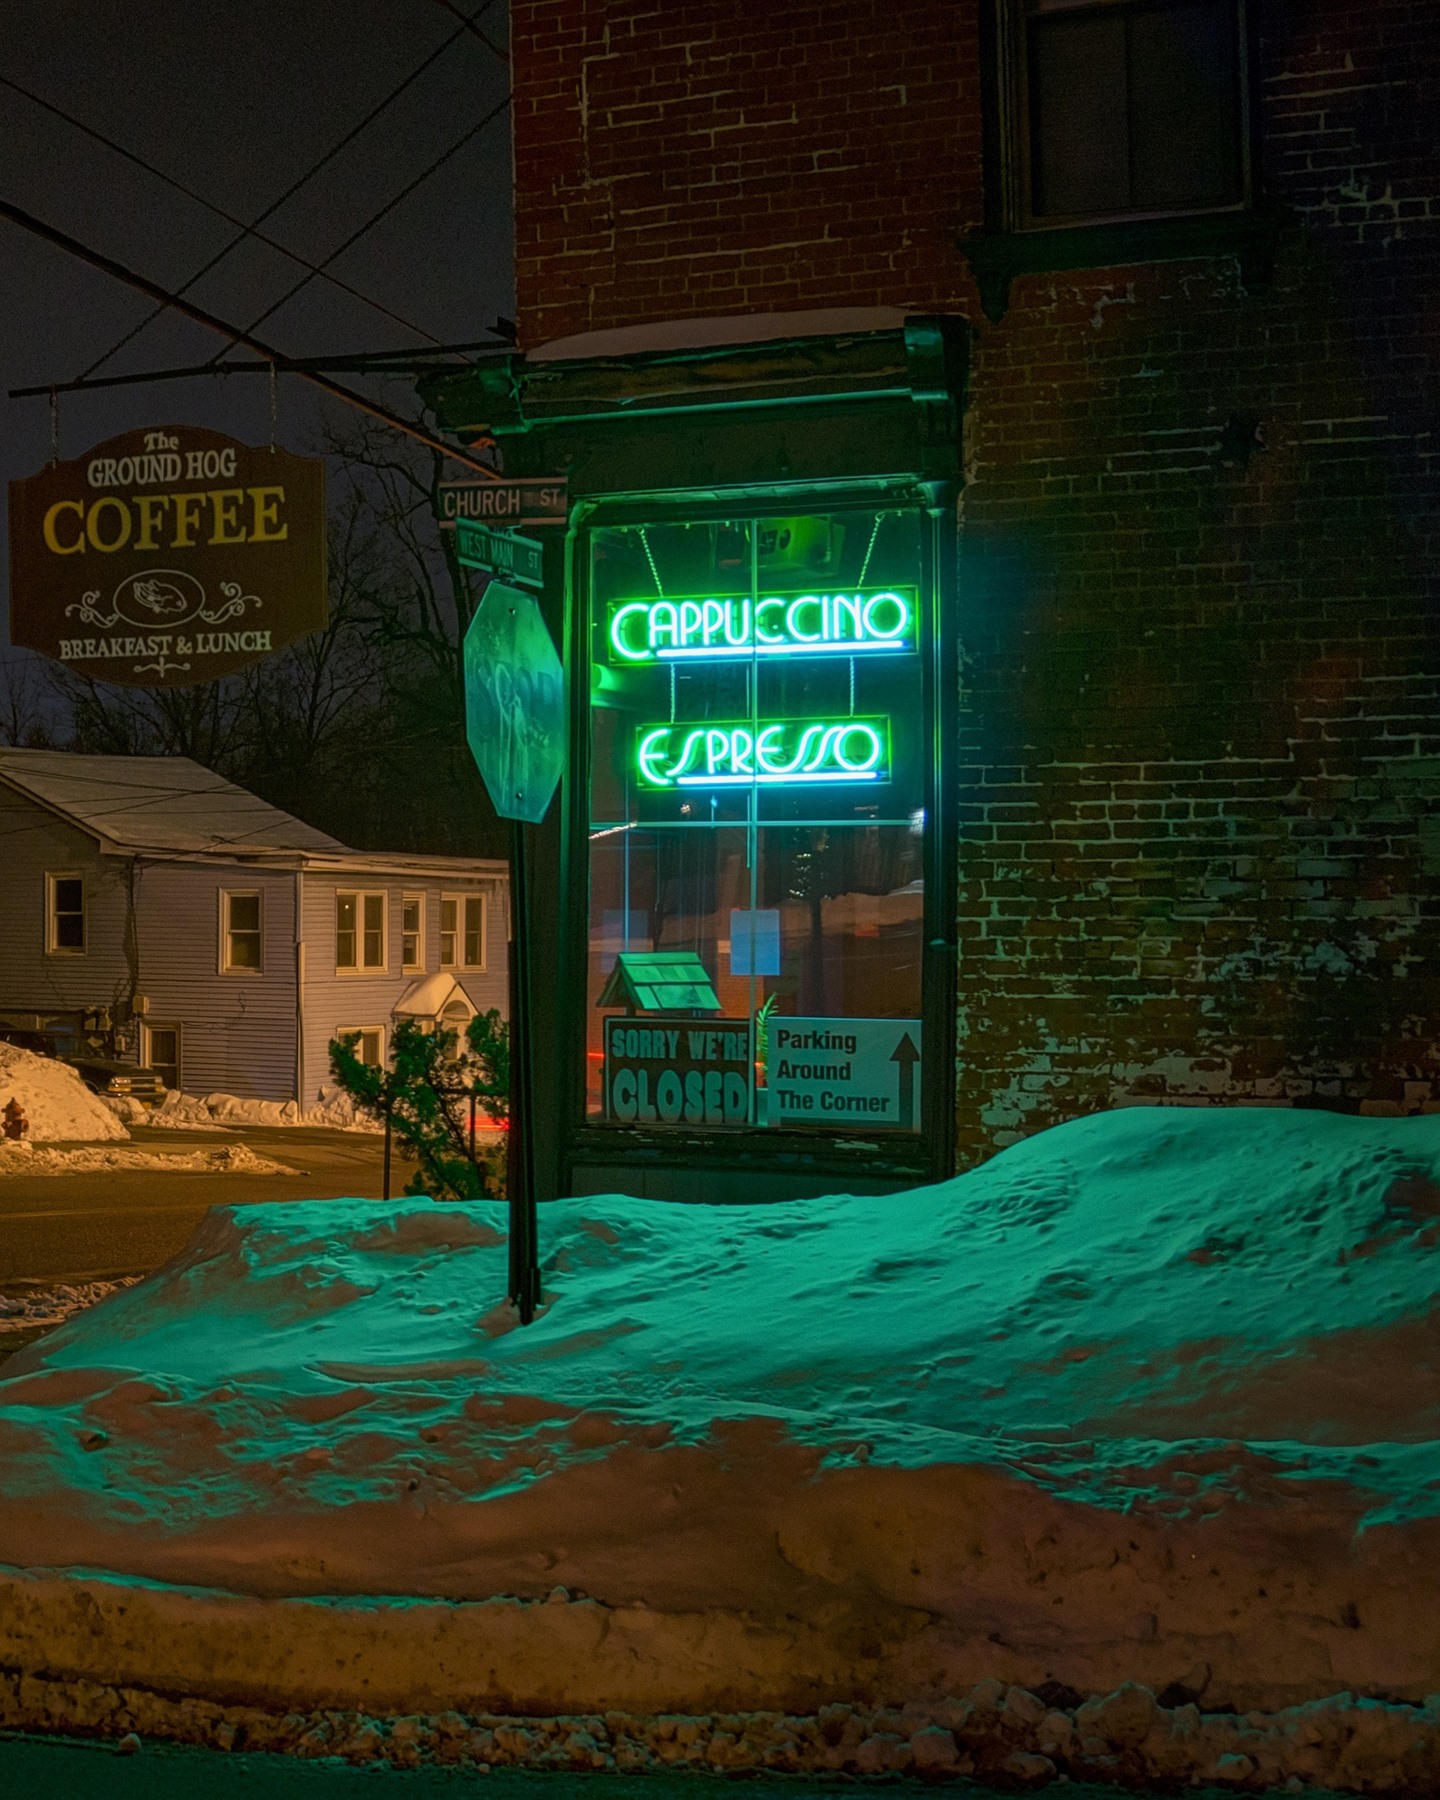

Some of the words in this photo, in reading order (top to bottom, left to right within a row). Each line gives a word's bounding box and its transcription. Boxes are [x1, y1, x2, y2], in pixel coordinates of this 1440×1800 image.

[144, 432, 179, 451] The
[87, 454, 182, 487] GROUND
[185, 447, 237, 480] HOG
[444, 489, 521, 517] CHURCH
[540, 488, 560, 506] ST
[43, 486, 289, 555] COFFEE
[460, 529, 486, 560] WEST
[490, 537, 514, 568] MAIN
[528, 551, 538, 569] ST
[611, 592, 909, 660] CAPPUCCINO
[59, 635, 173, 660] BREAKFAST
[176, 637, 192, 653] &
[196, 630, 272, 654] LUNCH
[638, 725, 881, 785] ESPRESSO
[611, 1028, 680, 1061] SORRY
[688, 1030, 748, 1062] WE'RE
[777, 1030, 857, 1054] Parking
[777, 1060, 851, 1081] Around
[612, 1068, 748, 1123] CLOSED
[777, 1090, 813, 1110] The
[820, 1091, 891, 1113] Corner
